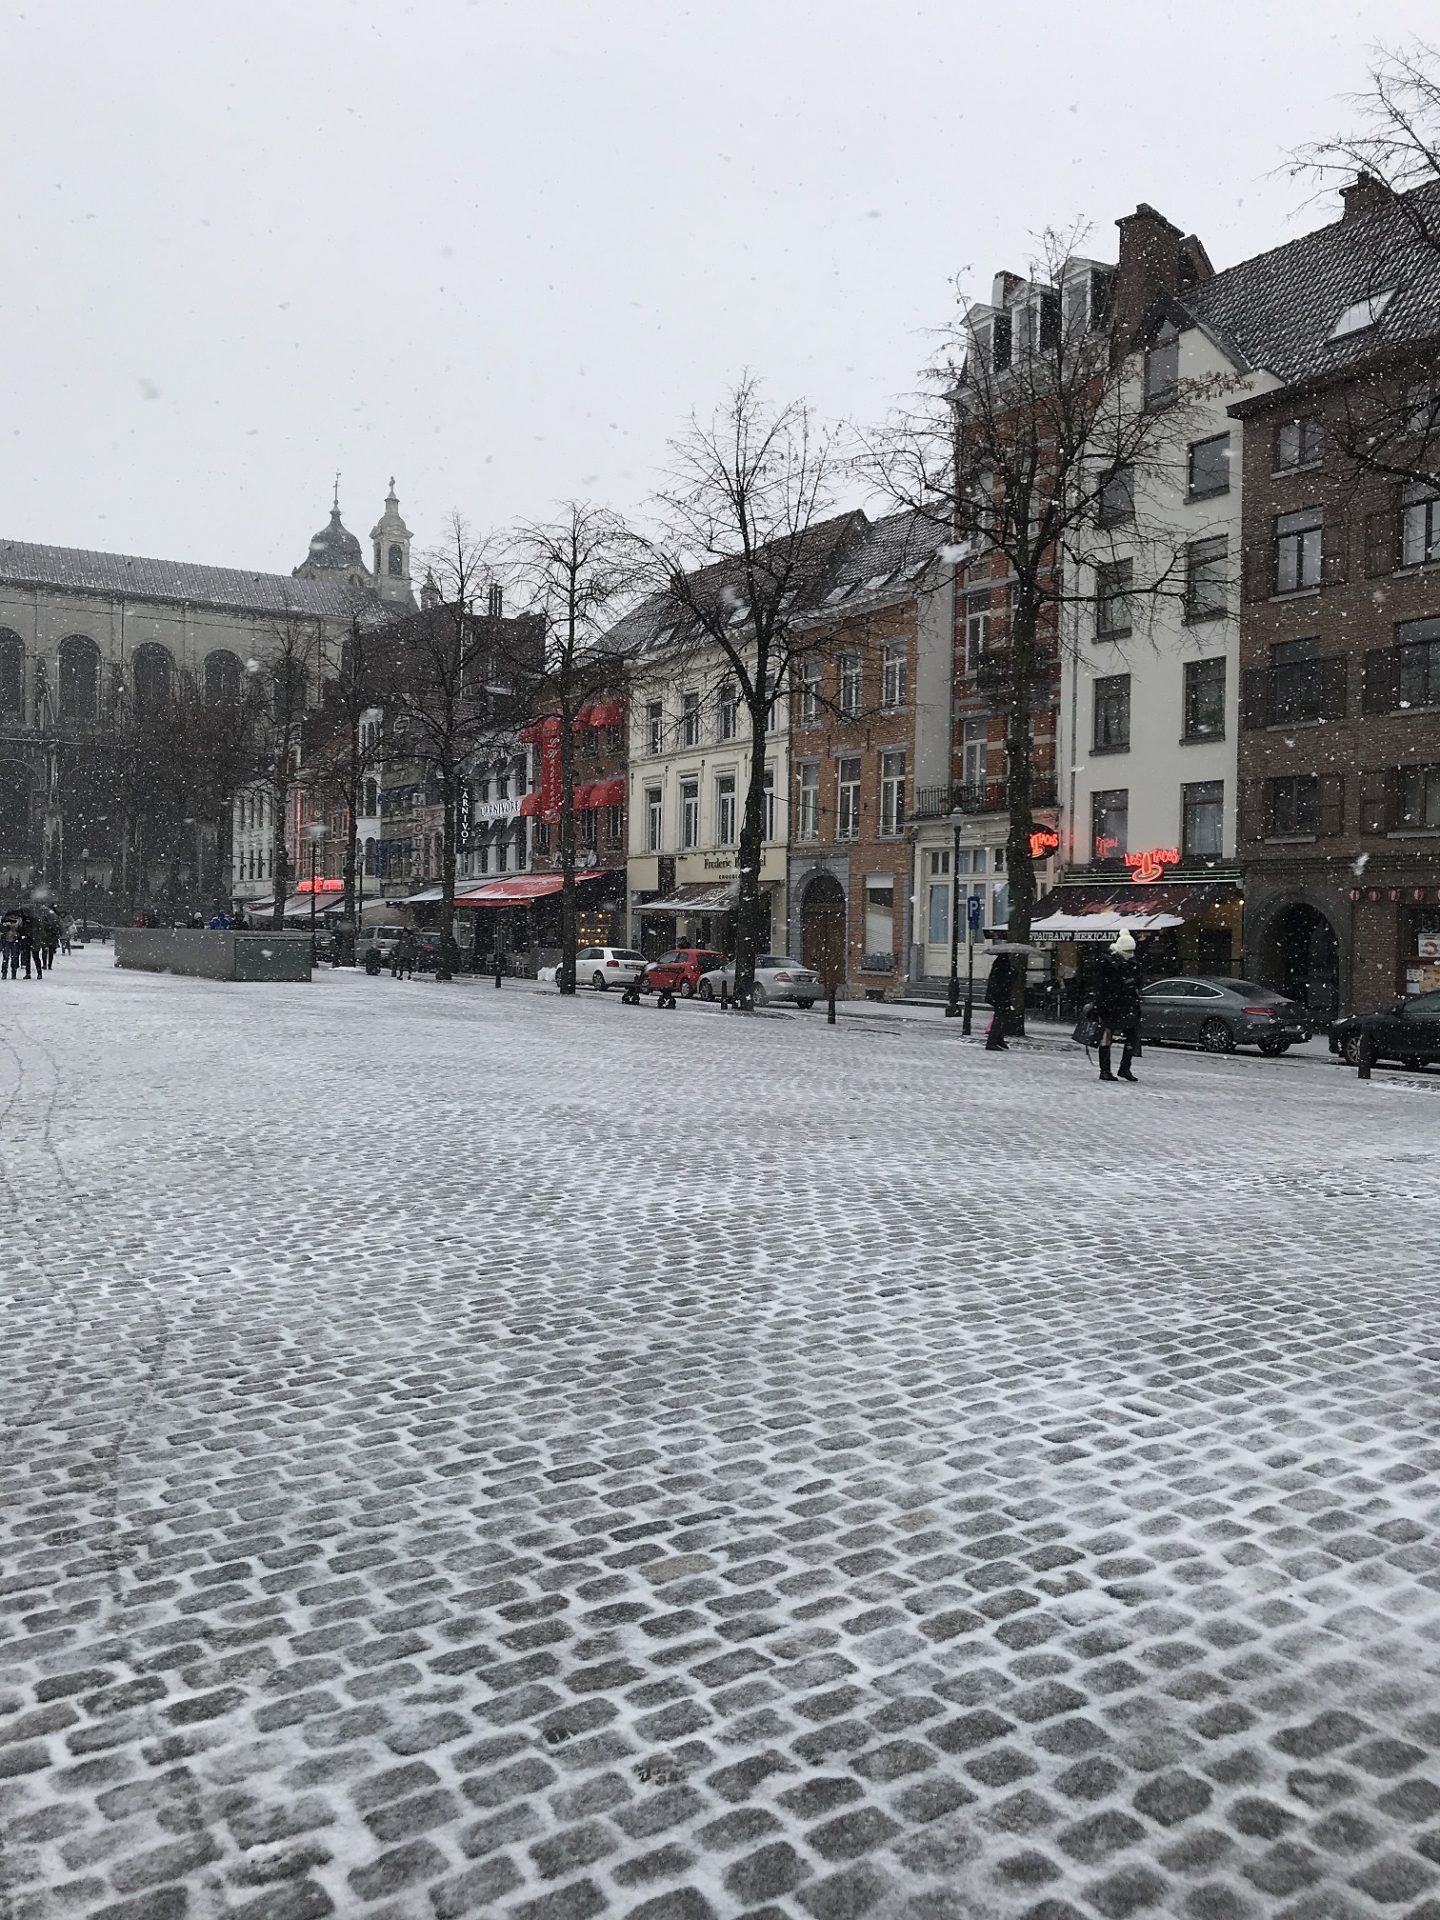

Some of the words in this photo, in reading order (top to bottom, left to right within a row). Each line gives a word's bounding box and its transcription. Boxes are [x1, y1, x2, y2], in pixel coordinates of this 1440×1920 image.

[1124, 852, 1143, 867] LOS
[1150, 848, 1180, 864] TACOS
[970, 900, 979, 918] P
[1029, 931, 1072, 942] STAURANT
